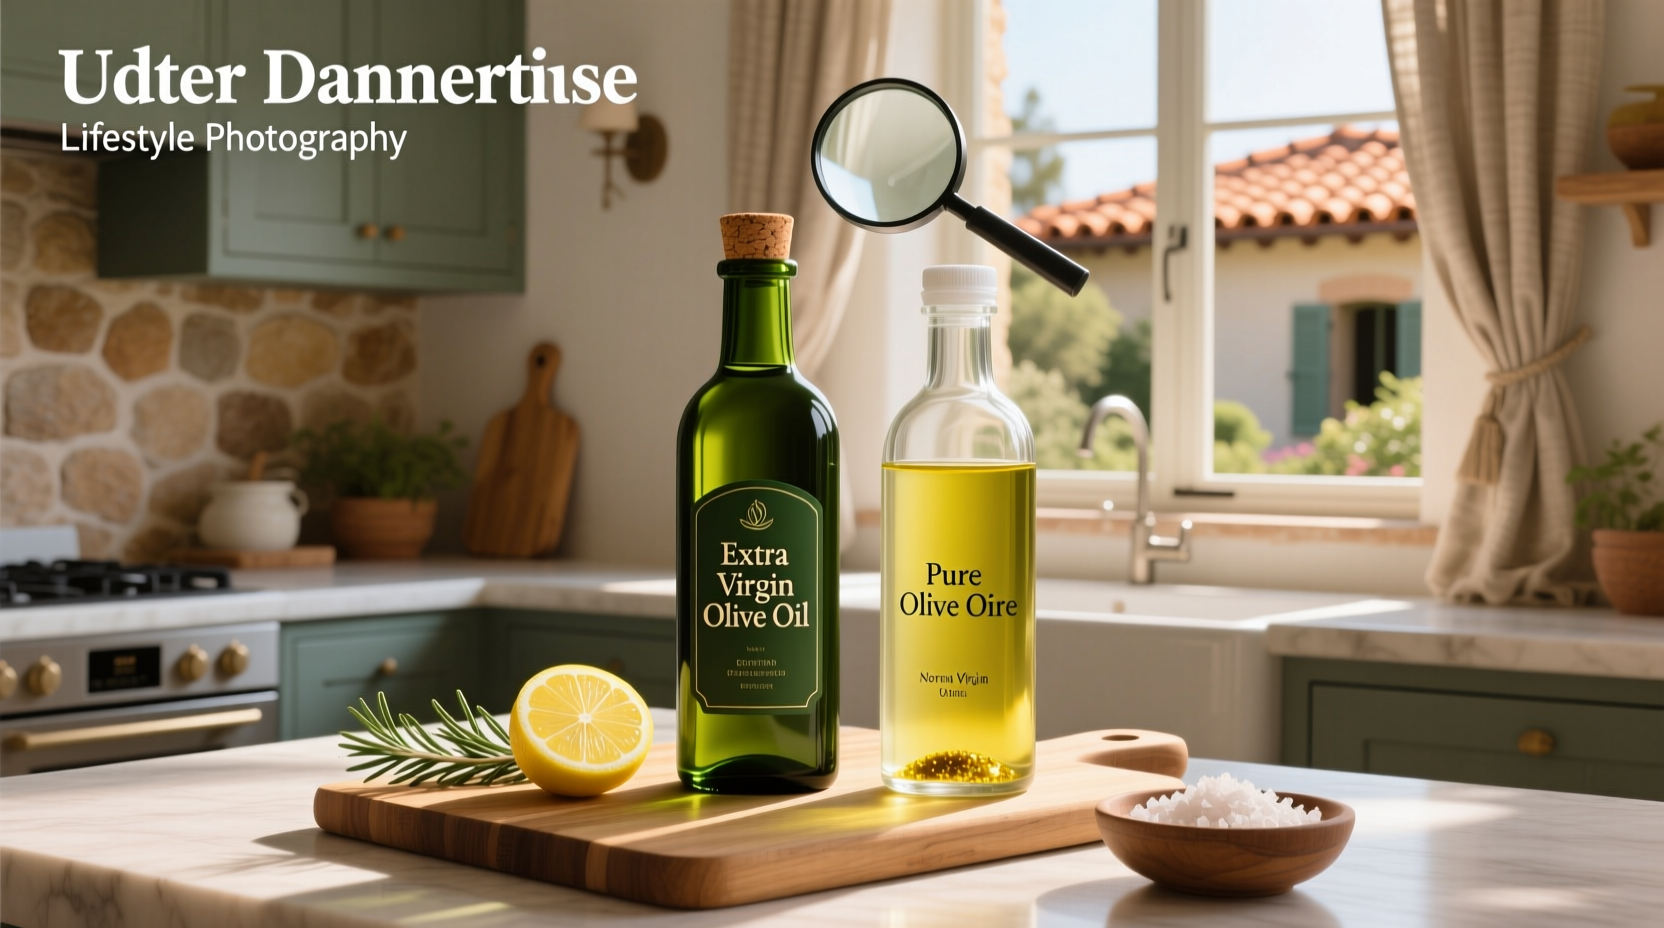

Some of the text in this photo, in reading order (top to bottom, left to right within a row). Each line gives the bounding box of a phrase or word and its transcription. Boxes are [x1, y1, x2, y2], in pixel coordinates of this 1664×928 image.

[720, 541, 789, 566] Extra
[926, 562, 982, 586] Pure
[717, 572, 794, 604] Virgin
[703, 601, 810, 628] Olive Oil
[899, 591, 1018, 617] Olive Oire
